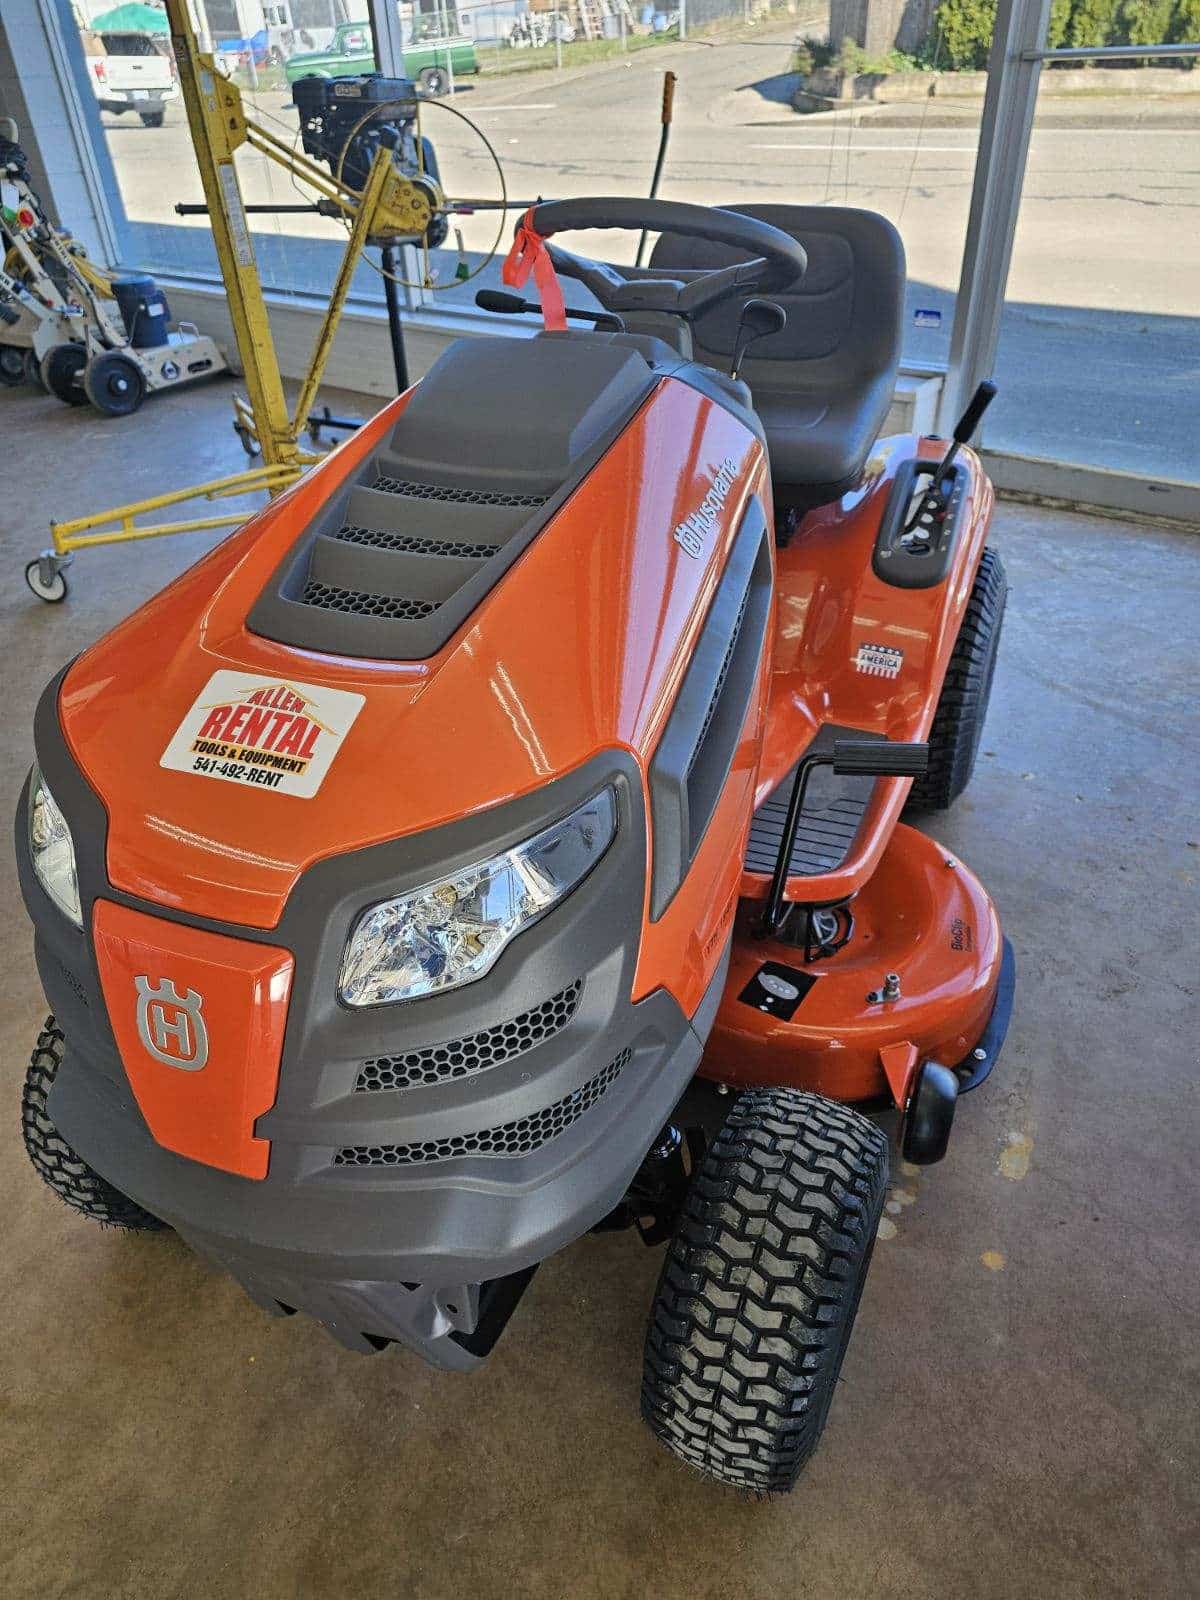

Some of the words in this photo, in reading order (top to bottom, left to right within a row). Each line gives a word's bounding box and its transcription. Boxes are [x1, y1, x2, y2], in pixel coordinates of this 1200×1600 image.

[686, 455, 738, 541] Husqvarna
[861, 654, 898, 668] AMERICA
[247, 686, 306, 713] ALLEN
[198, 705, 323, 759] RENTAL
[192, 740, 229, 757] TOOLS
[228, 747, 237, 759] &
[238, 750, 306, 773] EQUIPMENT
[193, 757, 284, 787] 541-492-RENT
